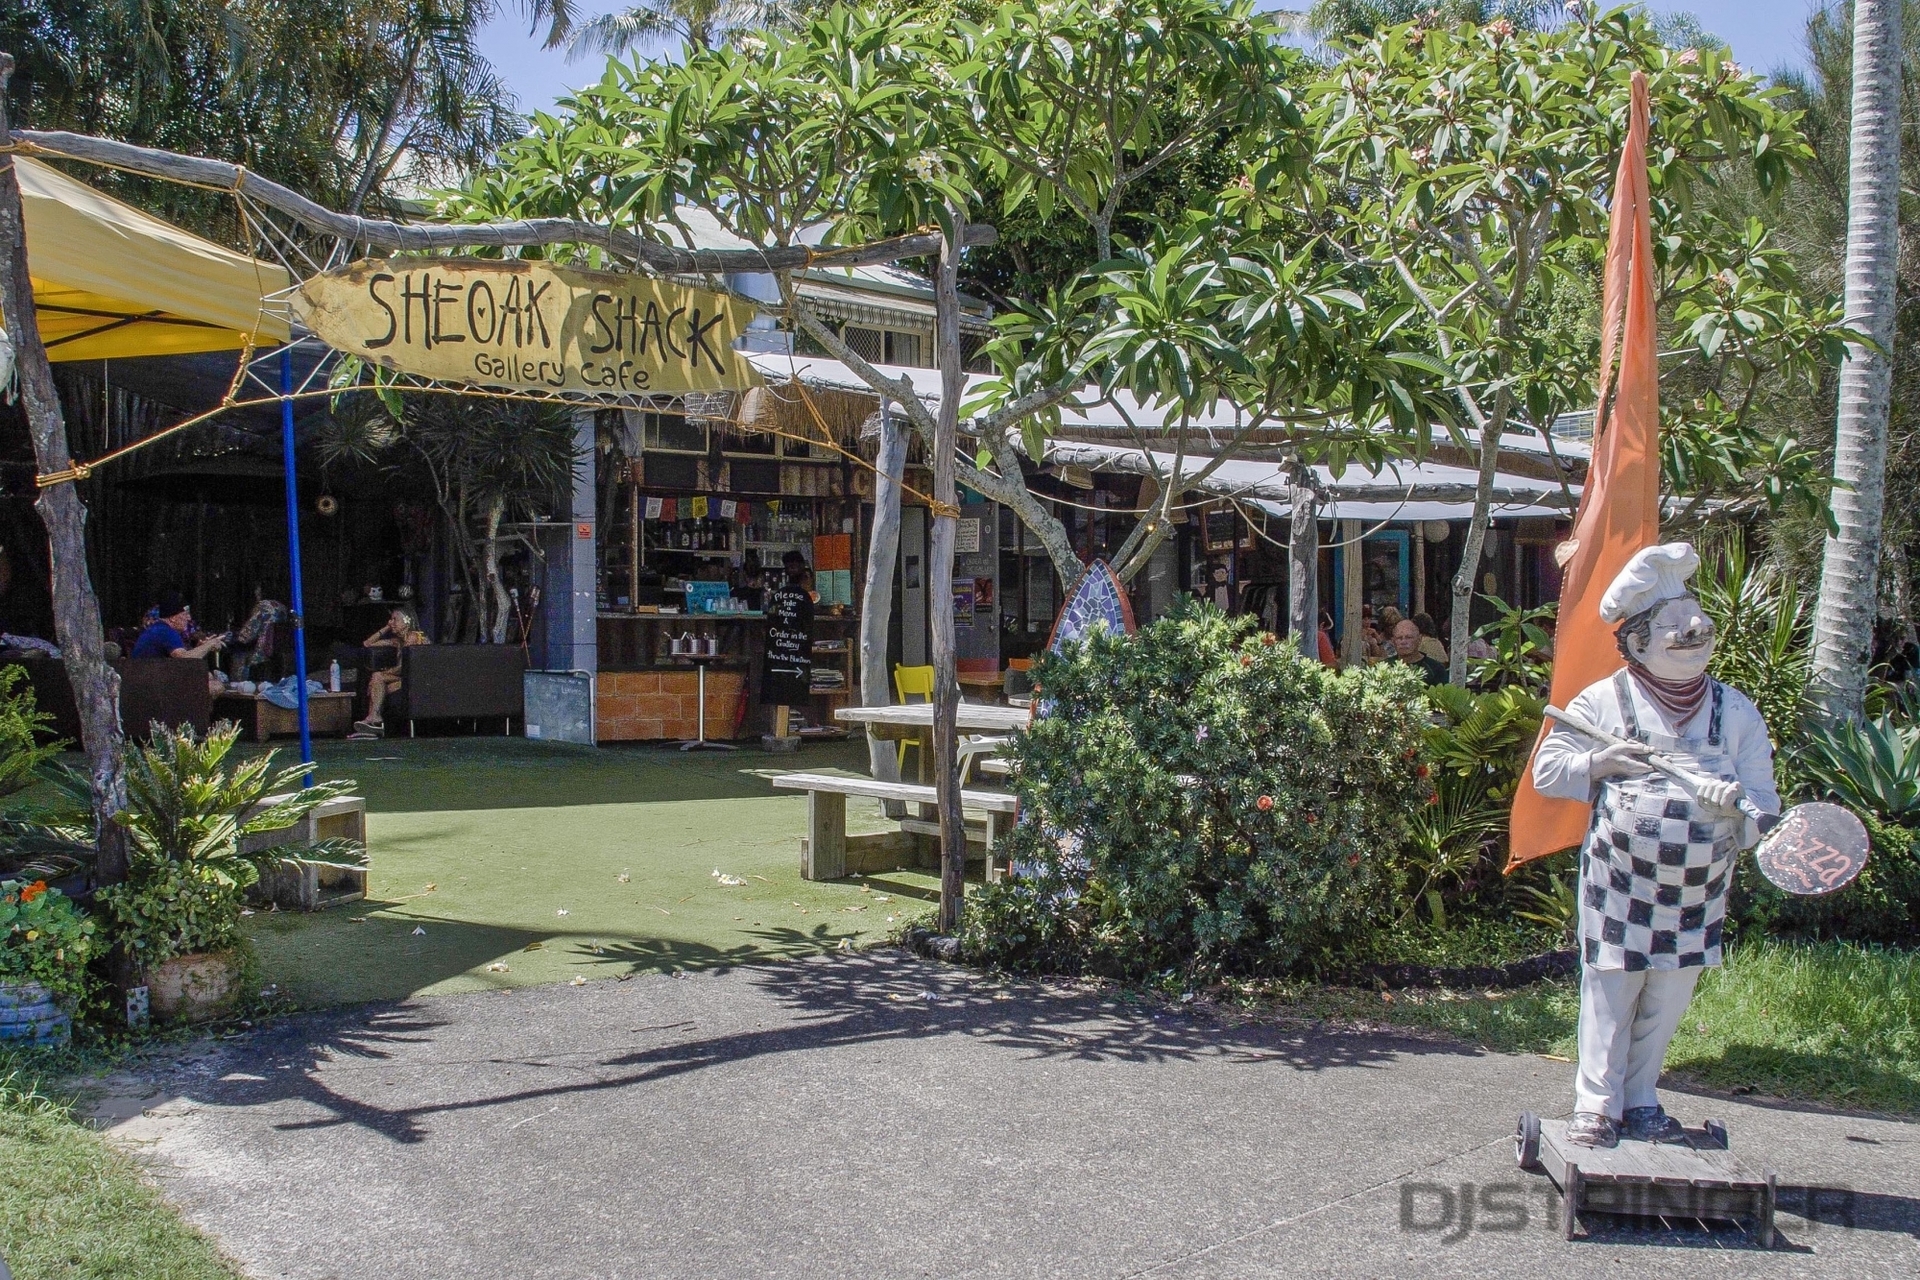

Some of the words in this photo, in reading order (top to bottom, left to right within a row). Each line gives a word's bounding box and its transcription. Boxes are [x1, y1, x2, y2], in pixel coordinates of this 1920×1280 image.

[364, 272, 552, 349] SHEOAK
[590, 294, 726, 376] SHACK
[474, 352, 566, 387] Gallery
[769, 627, 790, 638] Order
[775, 639, 800, 650] Gallery
